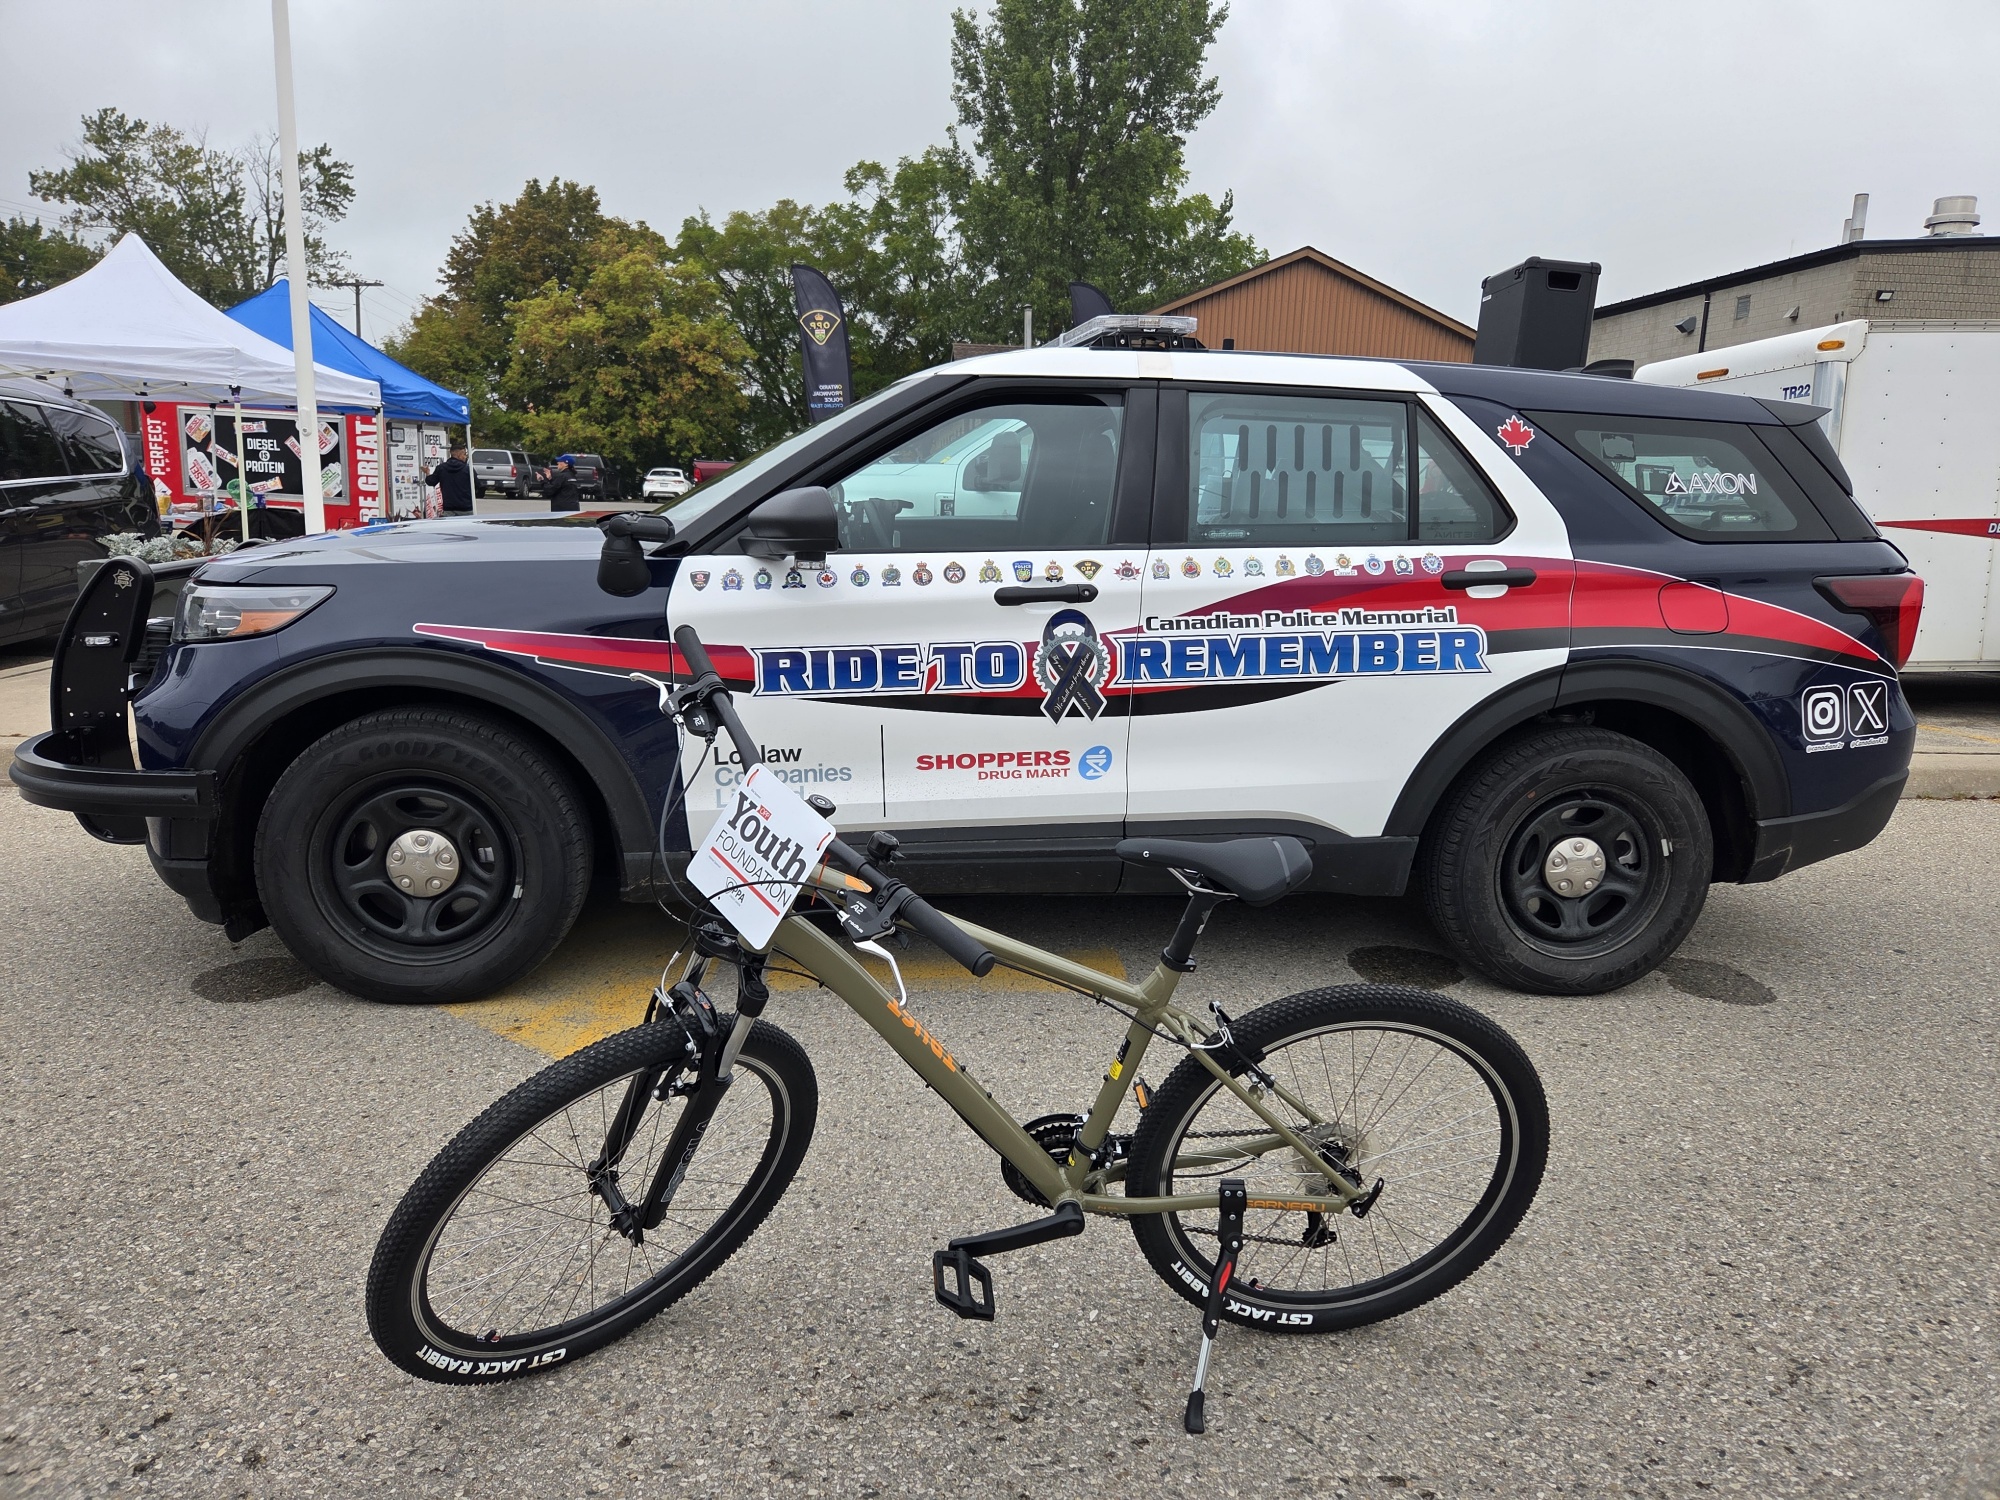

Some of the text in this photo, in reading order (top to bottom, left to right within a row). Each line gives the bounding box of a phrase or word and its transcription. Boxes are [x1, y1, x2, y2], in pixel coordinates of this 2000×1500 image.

[1782, 384, 1811, 400] TR22
[146, 417, 166, 475] PERFECT
[246, 437, 281, 452] DIESEL
[425, 434, 442, 445] DIESEL
[260, 451, 269, 460] IS
[245, 460, 285, 474] PROTEIN
[1689, 472, 1758, 495] AXON
[358, 496, 380, 523] BE
[1145, 606, 1456, 631] Canadian Police Memorial
[753, 628, 1489, 696] RIDE TO REMEMBER
[713, 746, 802, 766] Lolaw
[916, 750, 1071, 771] SHOPPERS
[714, 764, 852, 788] Copanies
[977, 767, 1071, 781] DRUG MART
[758, 807, 771, 820] OPP
[727, 790, 808, 889] Youth
[715, 829, 792, 908] FOUNDATION
[850, 903, 864, 915] A2
[1170, 1260, 1314, 1326] CST JACK ABBIT
[415, 1344, 567, 1375] CST JACK RABBIT
